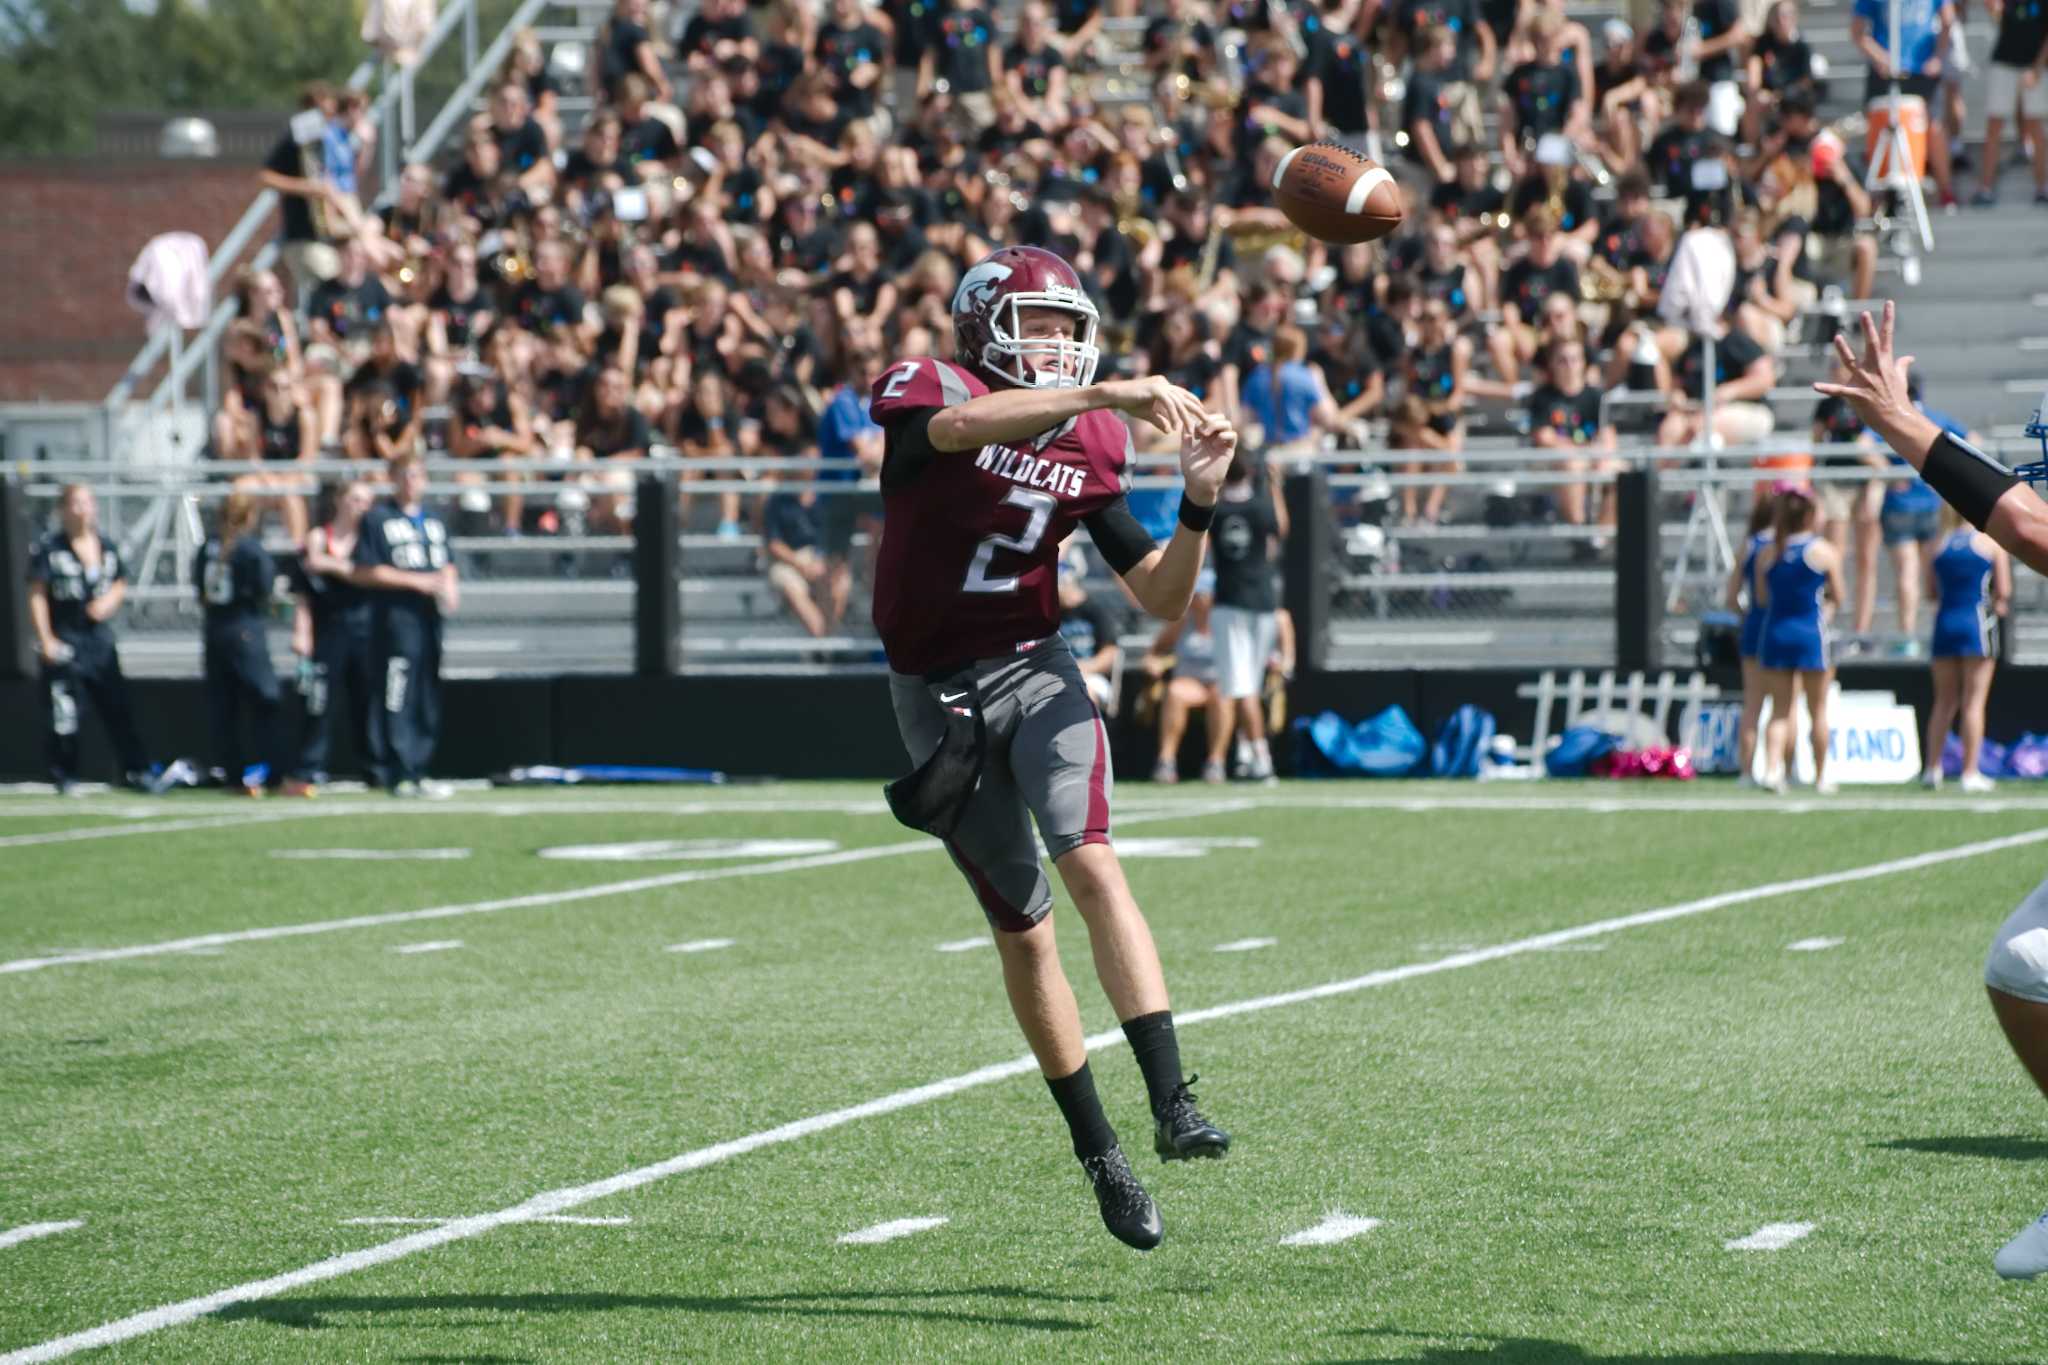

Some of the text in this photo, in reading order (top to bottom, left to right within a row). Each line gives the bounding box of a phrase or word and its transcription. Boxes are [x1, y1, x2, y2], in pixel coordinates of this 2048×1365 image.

[881, 361, 921, 398] 2
[974, 443, 1087, 497] WILDCATS
[962, 484, 1058, 594] 2
